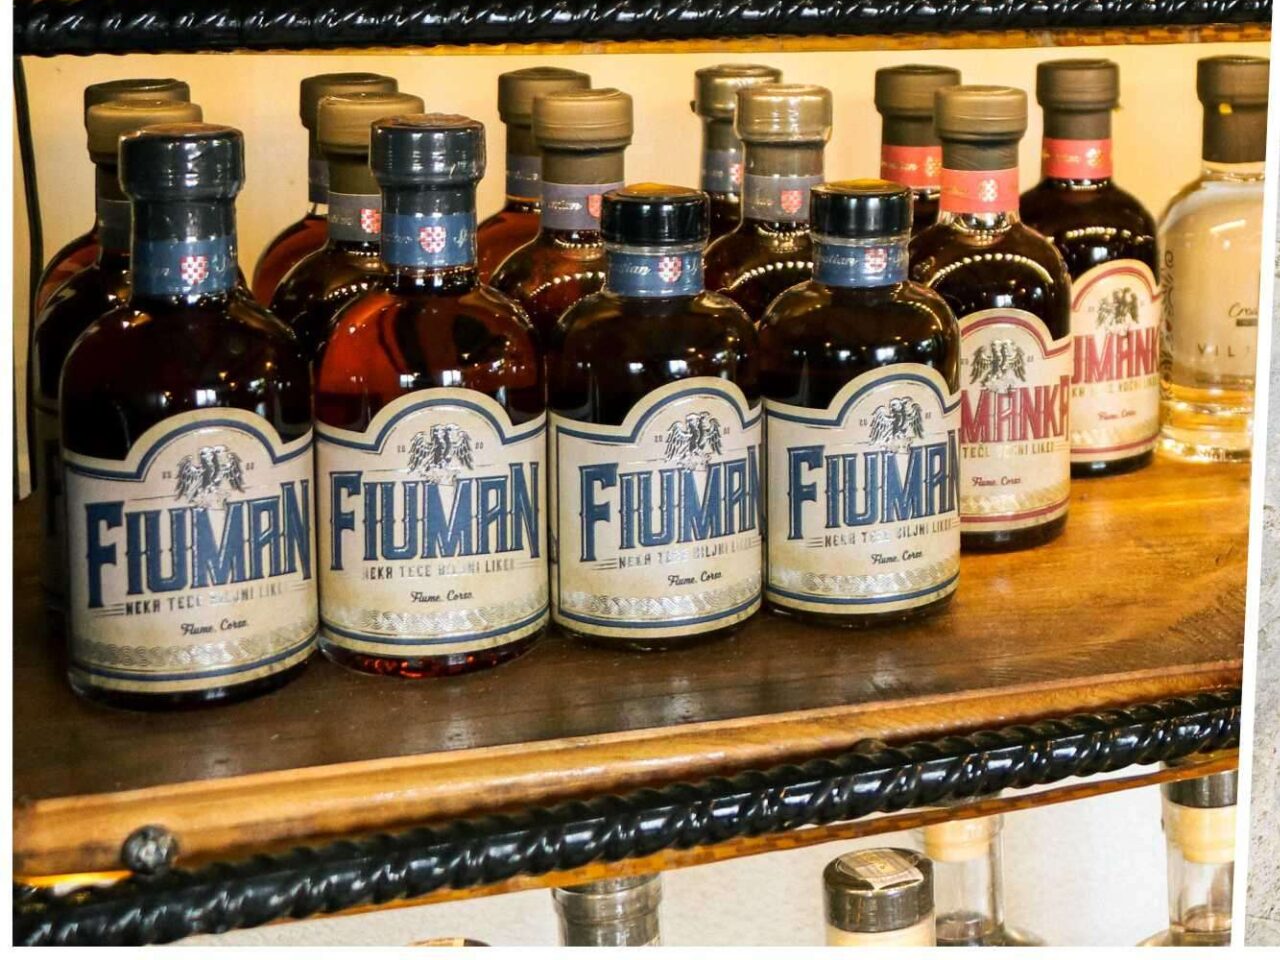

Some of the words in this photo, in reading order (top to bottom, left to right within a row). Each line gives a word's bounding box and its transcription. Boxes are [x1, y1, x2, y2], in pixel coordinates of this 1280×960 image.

[329, 461, 540, 571] FIUMAN
[579, 444, 764, 562] FIUMAN
[787, 430, 961, 540] FIUMAN
[85, 479, 312, 609] FIUMAN
[126, 598, 161, 616] NEKA
